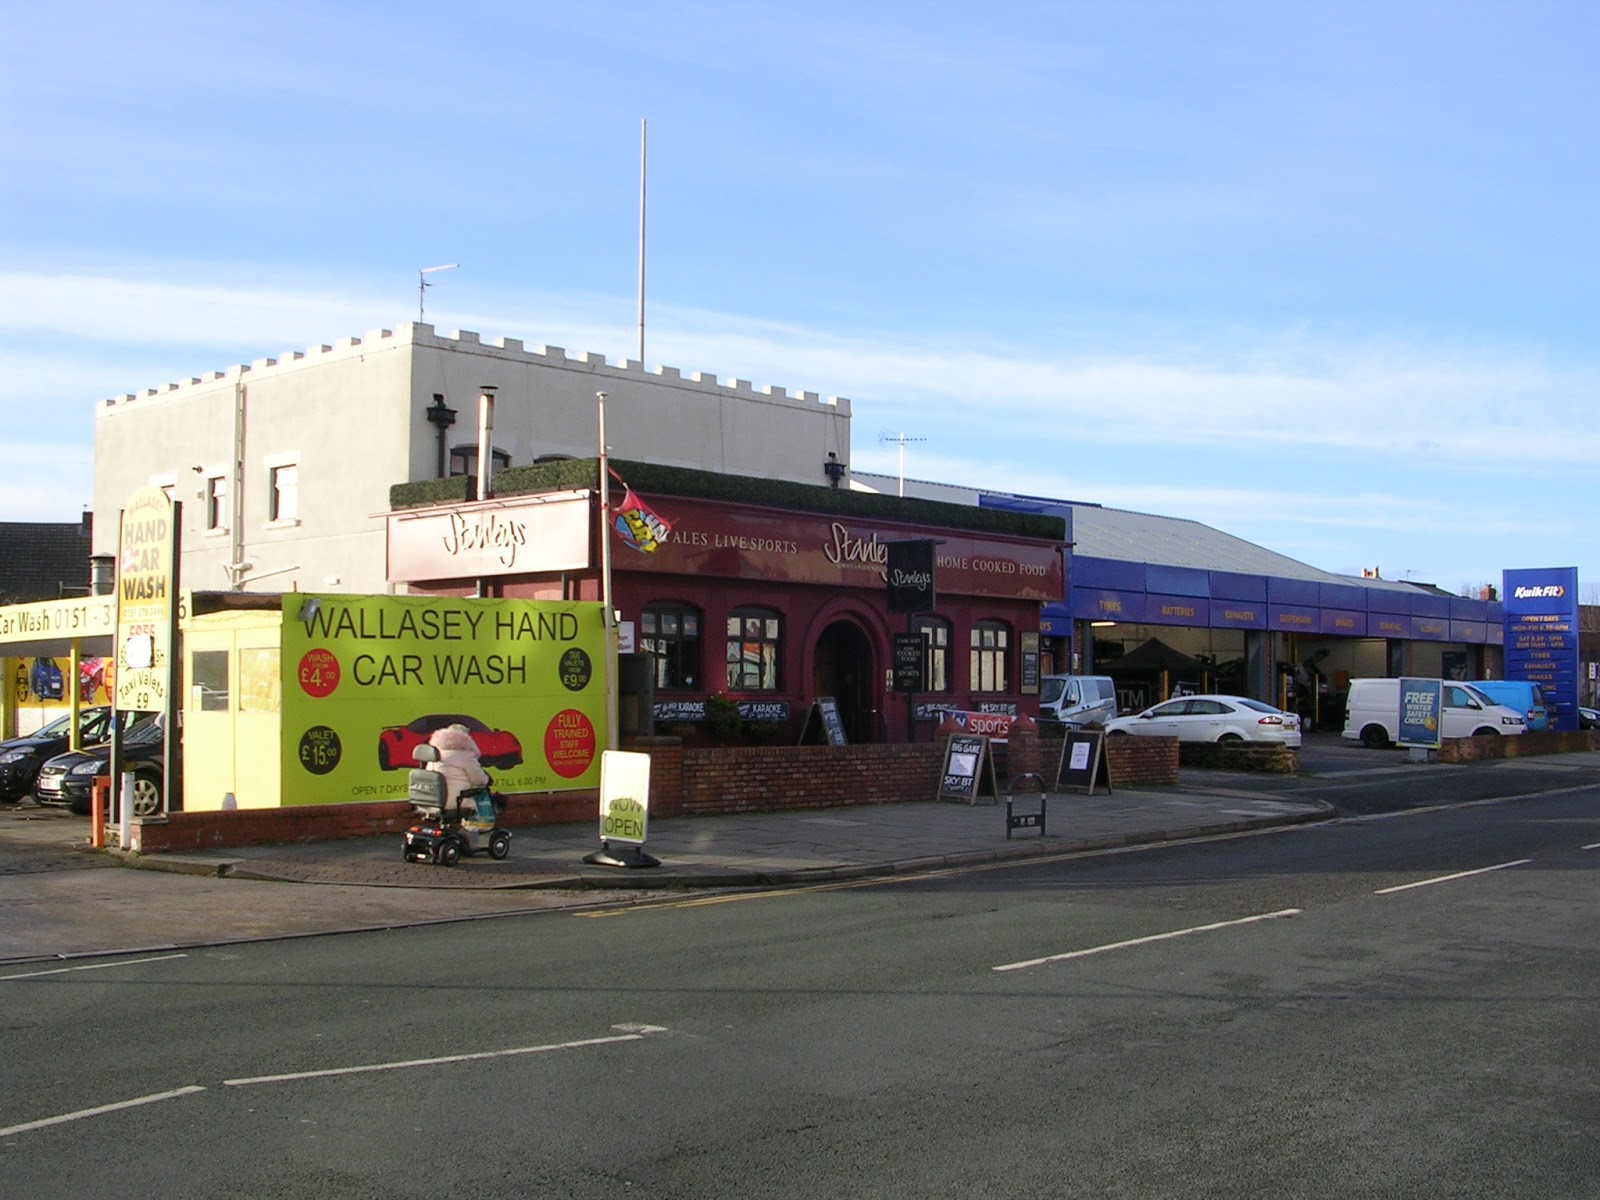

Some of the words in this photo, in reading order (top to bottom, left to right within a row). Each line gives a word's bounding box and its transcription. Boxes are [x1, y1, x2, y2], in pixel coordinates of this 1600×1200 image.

[125, 519, 167, 545] HAND
[442, 512, 526, 568] Stanleys
[672, 530, 708, 546] ALES
[715, 534, 747, 549] LIVE
[750, 536, 798, 554] SPORTS
[937, 556, 968, 570] HOME
[972, 559, 1016, 574] COOKED
[1019, 564, 1046, 577] FOOD
[123, 575, 166, 600] WASH
[891, 569, 931, 592] Stanleys
[1099, 600, 1122, 612] TYRES
[1161, 606, 1195, 618] BATTERIES
[18, 608, 50, 632] Wash
[55, 606, 87, 629] 0151
[303, 606, 484, 640] WALLASEY
[495, 610, 579, 641] HAND
[1224, 610, 1255, 621] EXHAUSTS
[307, 654, 334, 663] WASH
[353, 654, 424, 686] CAR
[433, 655, 527, 685] WASH
[138, 670, 165, 698] Valets
[136, 692, 149, 709] £9
[1404, 691, 1435, 704] FREE
[752, 703, 782, 714] KARAOKE
[558, 714, 582, 728] FULLY
[970, 716, 1009, 735] sports
[308, 731, 334, 740] VALET
[553, 729, 589, 739] TRAINED
[560, 740, 579, 749] STAFF
[951, 742, 962, 752] BIG
[553, 749, 590, 759] WELCOME
[352, 785, 377, 796] OPEN
[379, 785, 385, 794] 7
[386, 783, 409, 794] DAYS
[500, 778, 515, 787] TILL
[535, 776, 547, 785] PM
[944, 776, 960, 785] SKY
[961, 777, 974, 786] BT
[604, 816, 643, 837] OPEN
